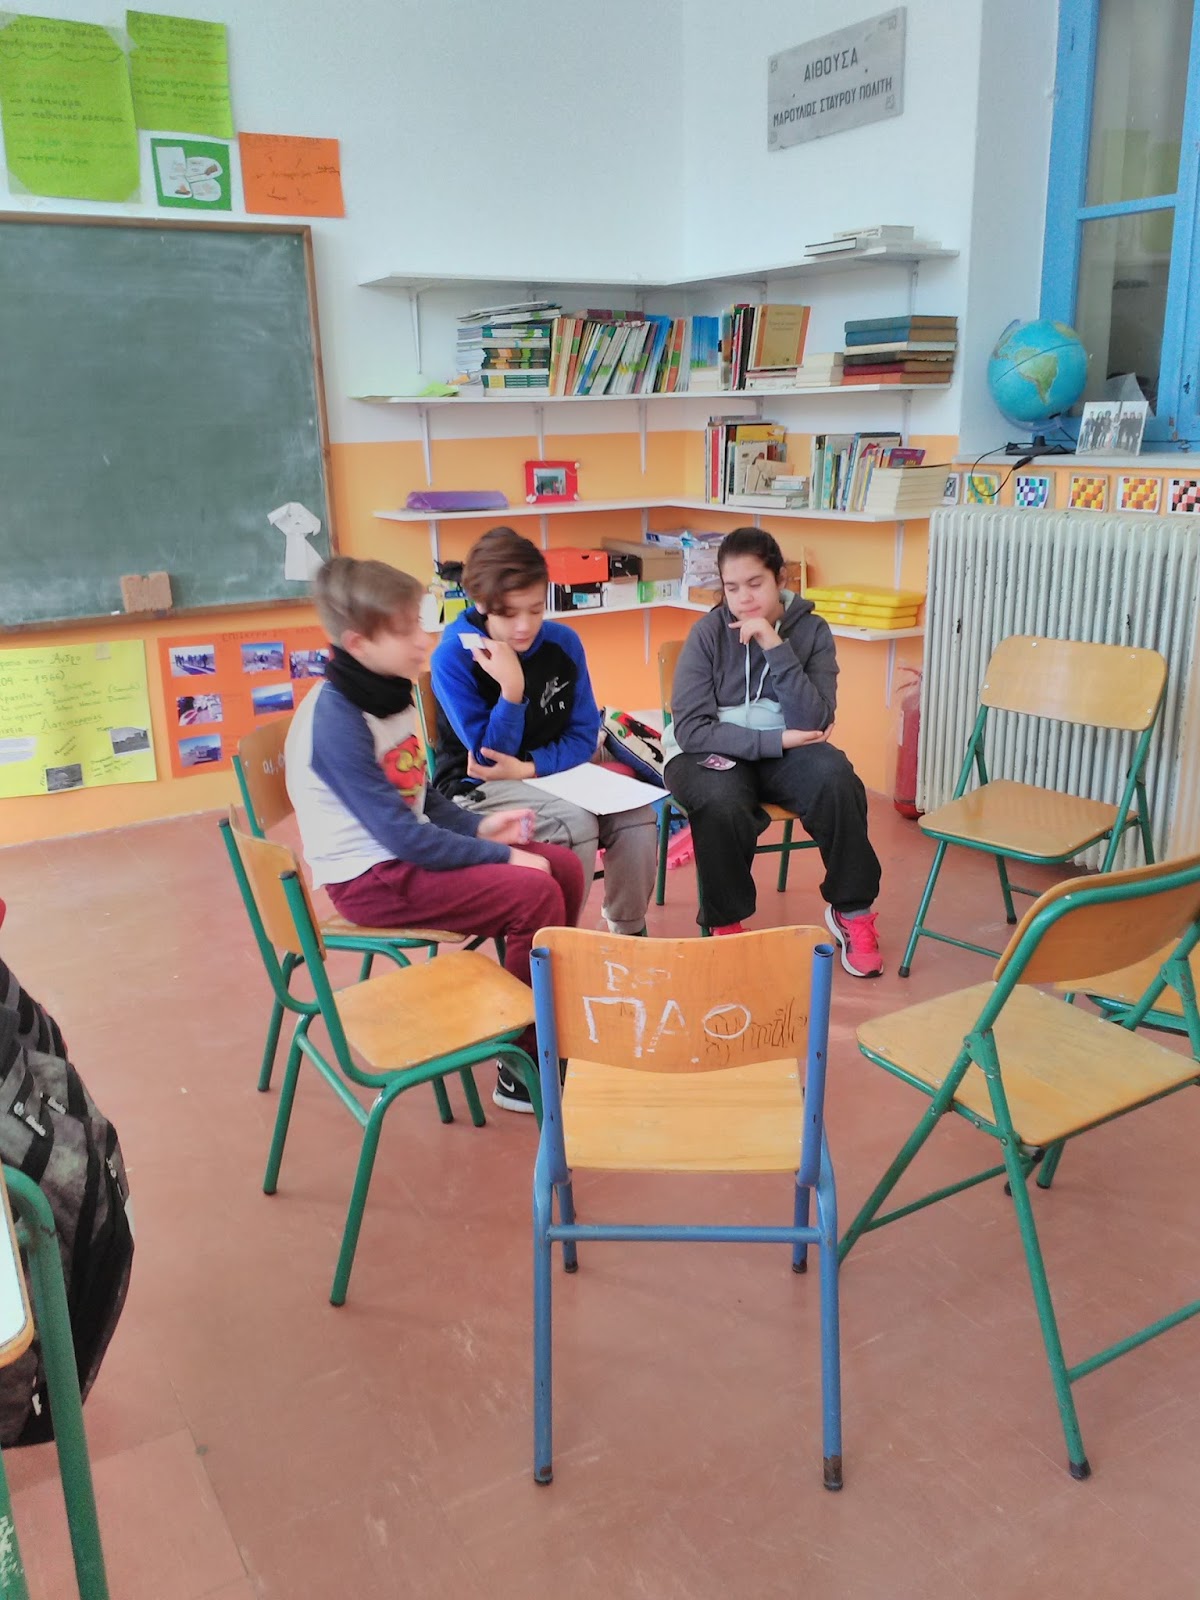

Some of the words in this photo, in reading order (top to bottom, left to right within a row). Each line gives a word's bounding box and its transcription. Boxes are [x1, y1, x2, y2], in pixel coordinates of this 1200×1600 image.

[804, 47, 859, 82] ΑΙΘΟΥΣΑ
[773, 101, 817, 128] ΜΑΡΟΥΛΙΩΣ
[819, 88, 857, 113] ΣΤΑΥΡΟΥ
[859, 77, 893, 100] ΠΟΛΙΤΗ
